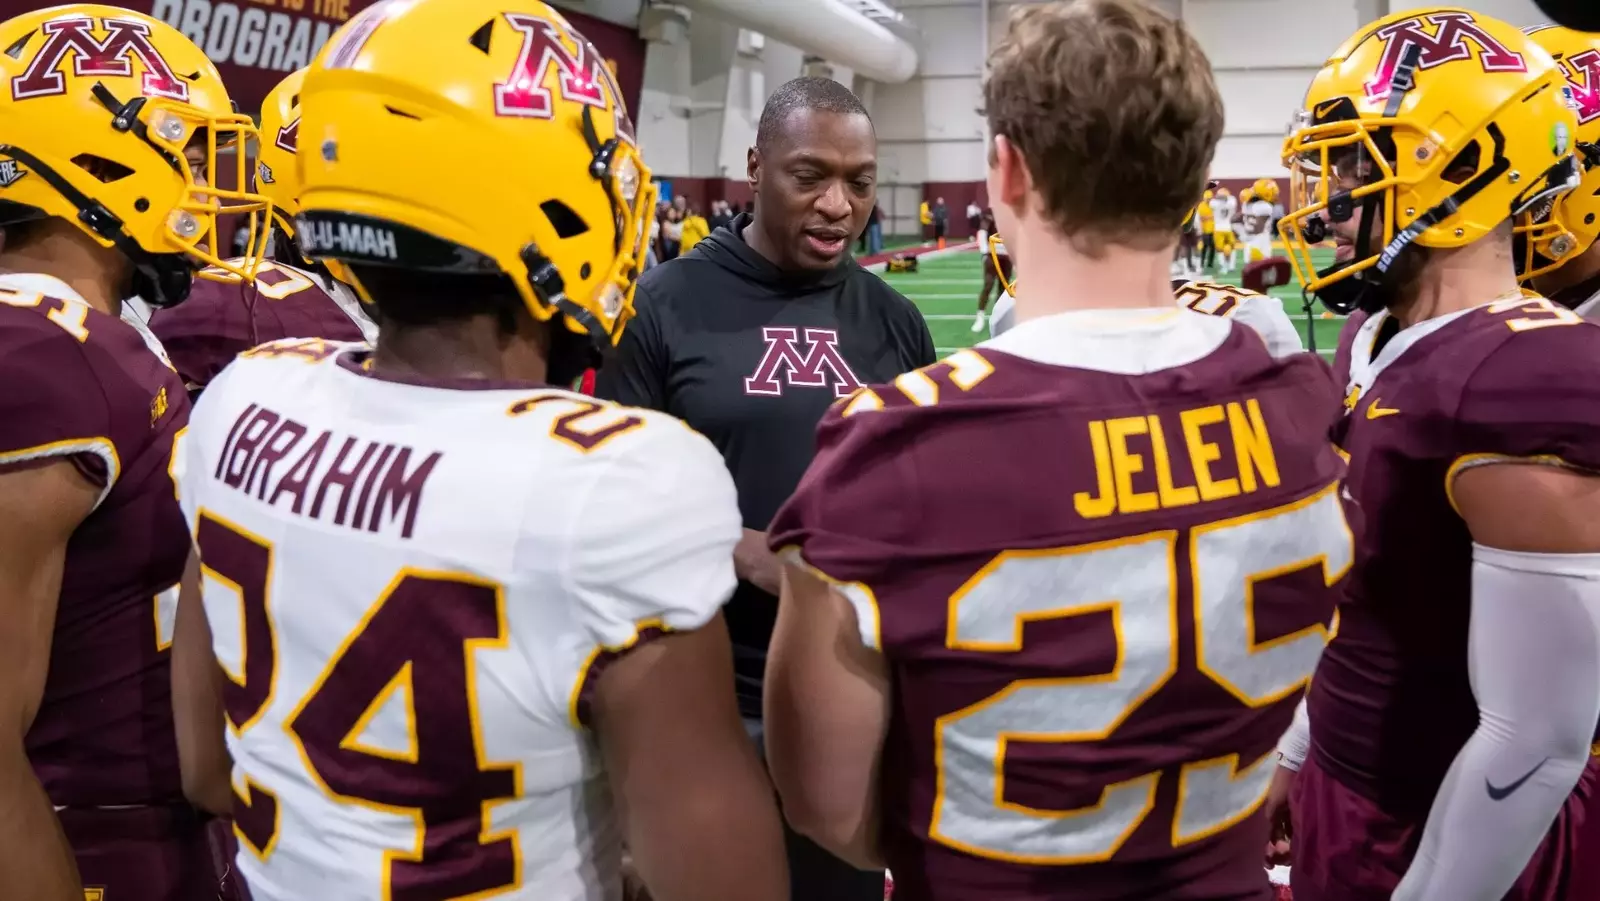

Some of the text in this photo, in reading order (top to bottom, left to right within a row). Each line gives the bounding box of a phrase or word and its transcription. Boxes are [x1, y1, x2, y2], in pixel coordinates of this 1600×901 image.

[152, 0, 340, 72] ROGRA
[744, 326, 866, 398] M
[214, 402, 444, 540] IBRAHIM
[1073, 398, 1281, 520] JELEN
[194, 505, 524, 901] 24
[929, 480, 1355, 865] 25
